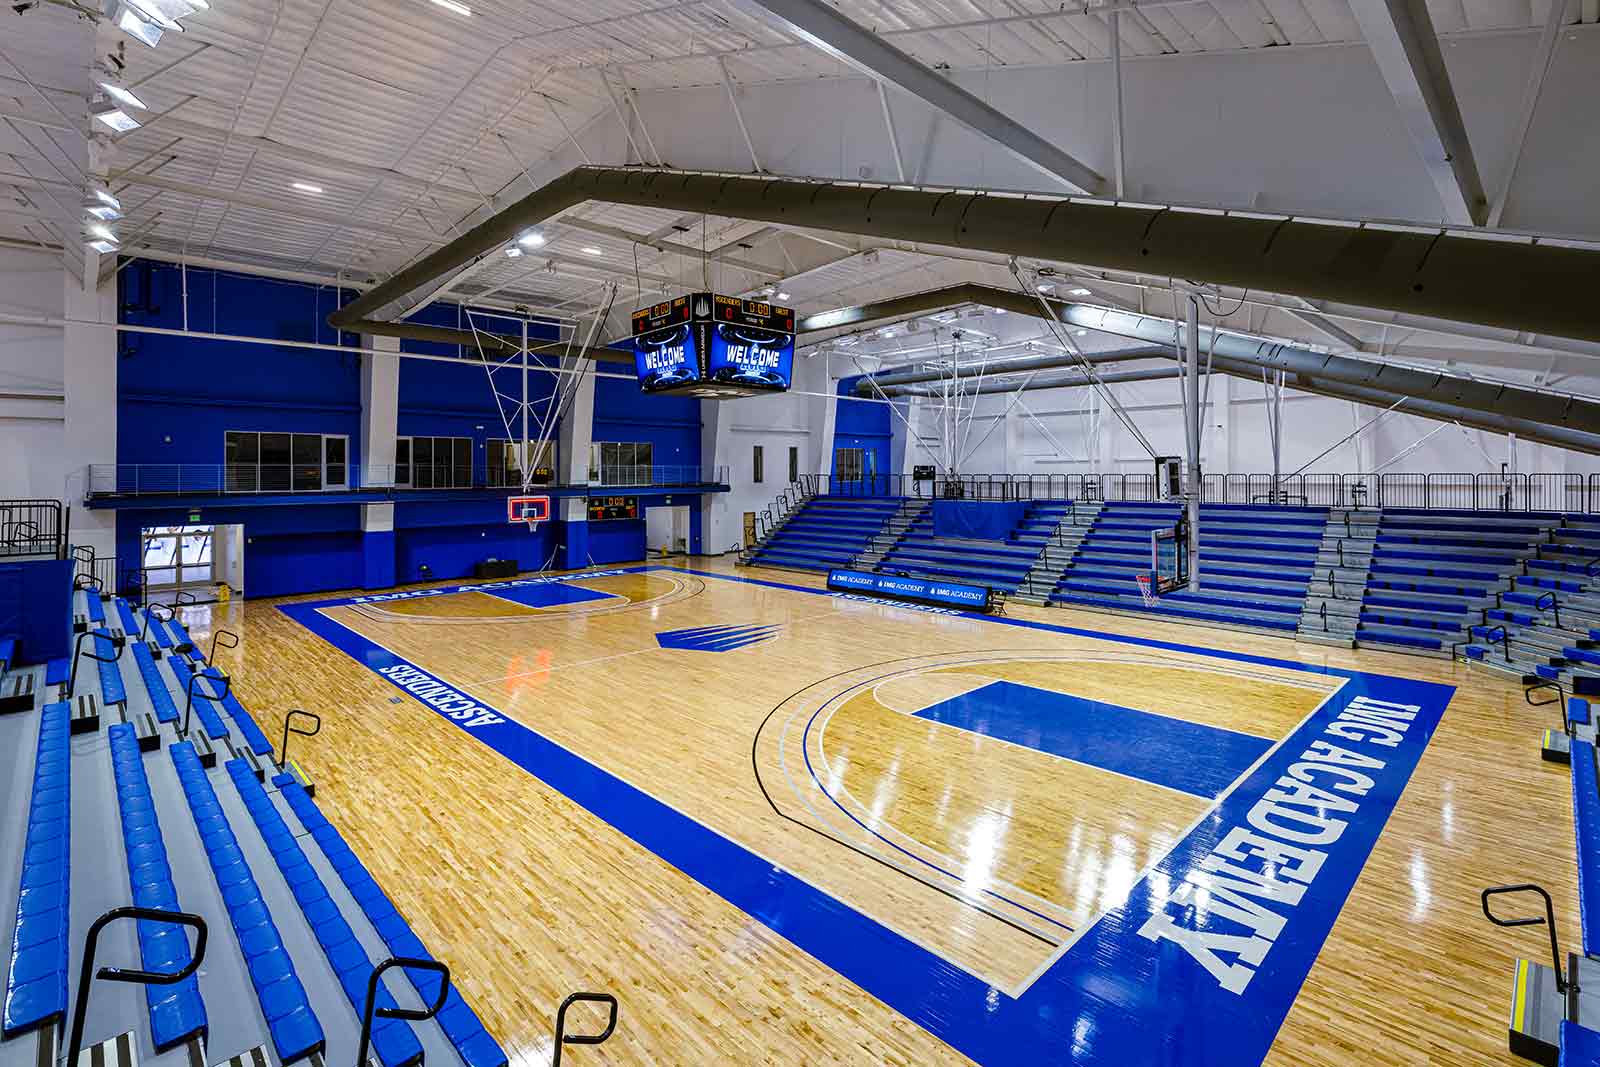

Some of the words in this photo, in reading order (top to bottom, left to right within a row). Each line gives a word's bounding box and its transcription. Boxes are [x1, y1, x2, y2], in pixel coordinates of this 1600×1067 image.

[645, 345, 685, 369] WELCOME
[726, 344, 780, 368] WELCOME
[836, 574, 847, 582] IMG
[847, 576, 874, 585] ACADEMY
[883, 581, 896, 589] IMG
[896, 582, 925, 593] ACADEMY
[350, 589, 444, 604] IMG
[936, 588, 950, 596] IMG
[950, 590, 983, 601] ACADEMY
[379, 664, 506, 727] ASCENDERS
[1323, 694, 1421, 748] IMG
[1136, 739, 1387, 996] ACADEMY
